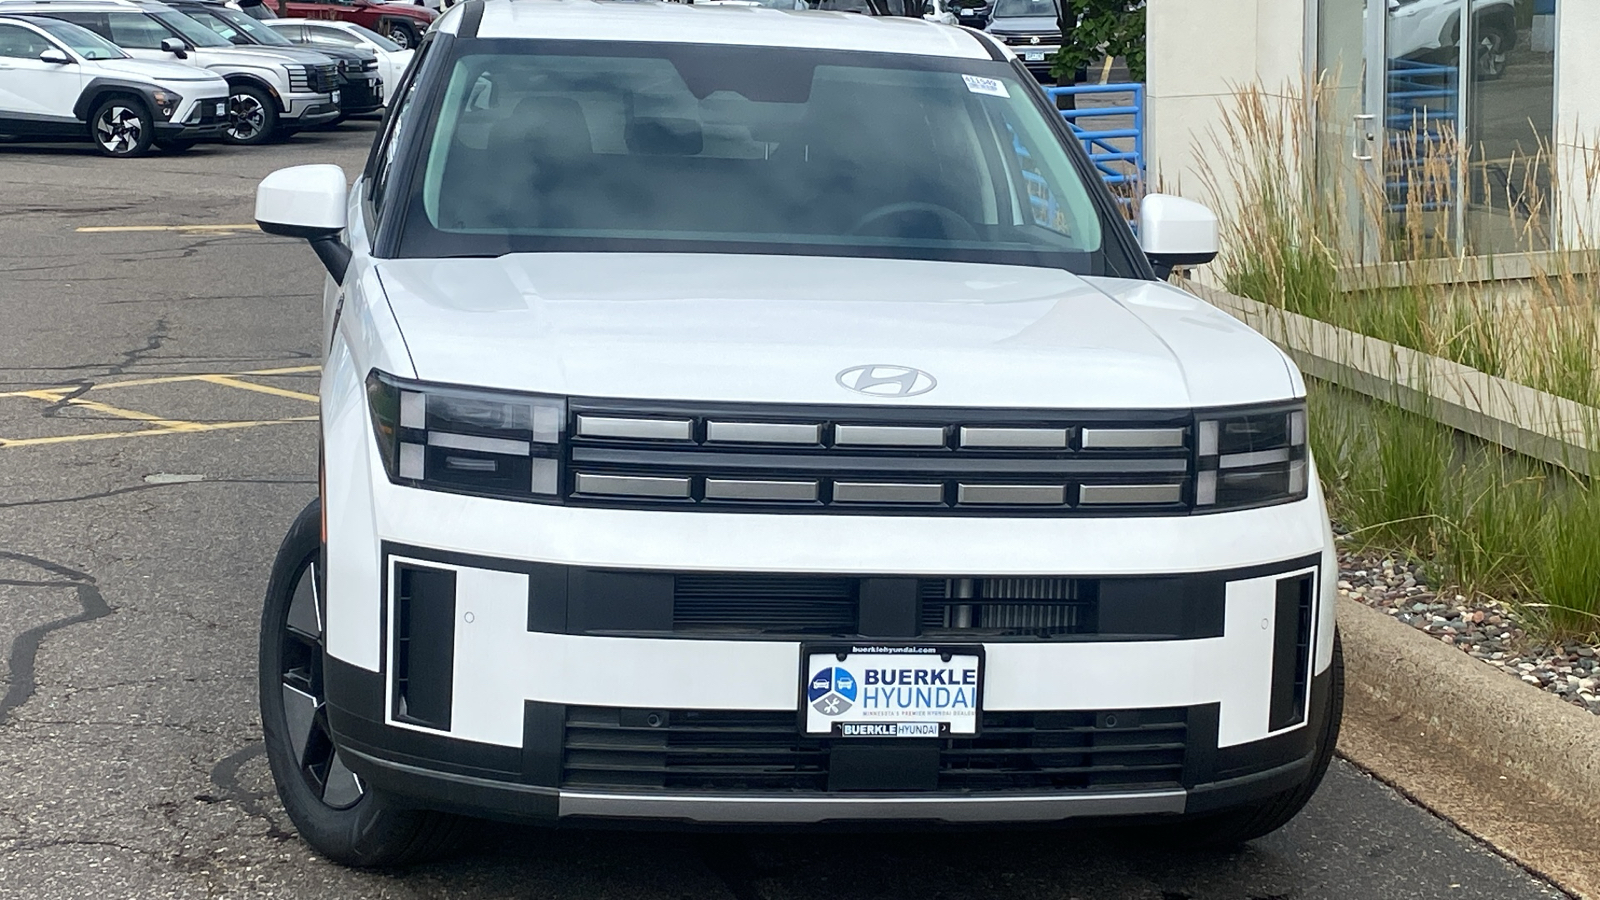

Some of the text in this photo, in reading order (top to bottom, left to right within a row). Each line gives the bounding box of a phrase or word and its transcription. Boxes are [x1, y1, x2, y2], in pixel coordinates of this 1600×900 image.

[852, 646, 937, 654] buerklehyundai.com
[864, 669, 976, 686] BUERKLE
[863, 687, 976, 708] HYUNDAI
[844, 724, 937, 735] BUERKLE HYUNDAI
